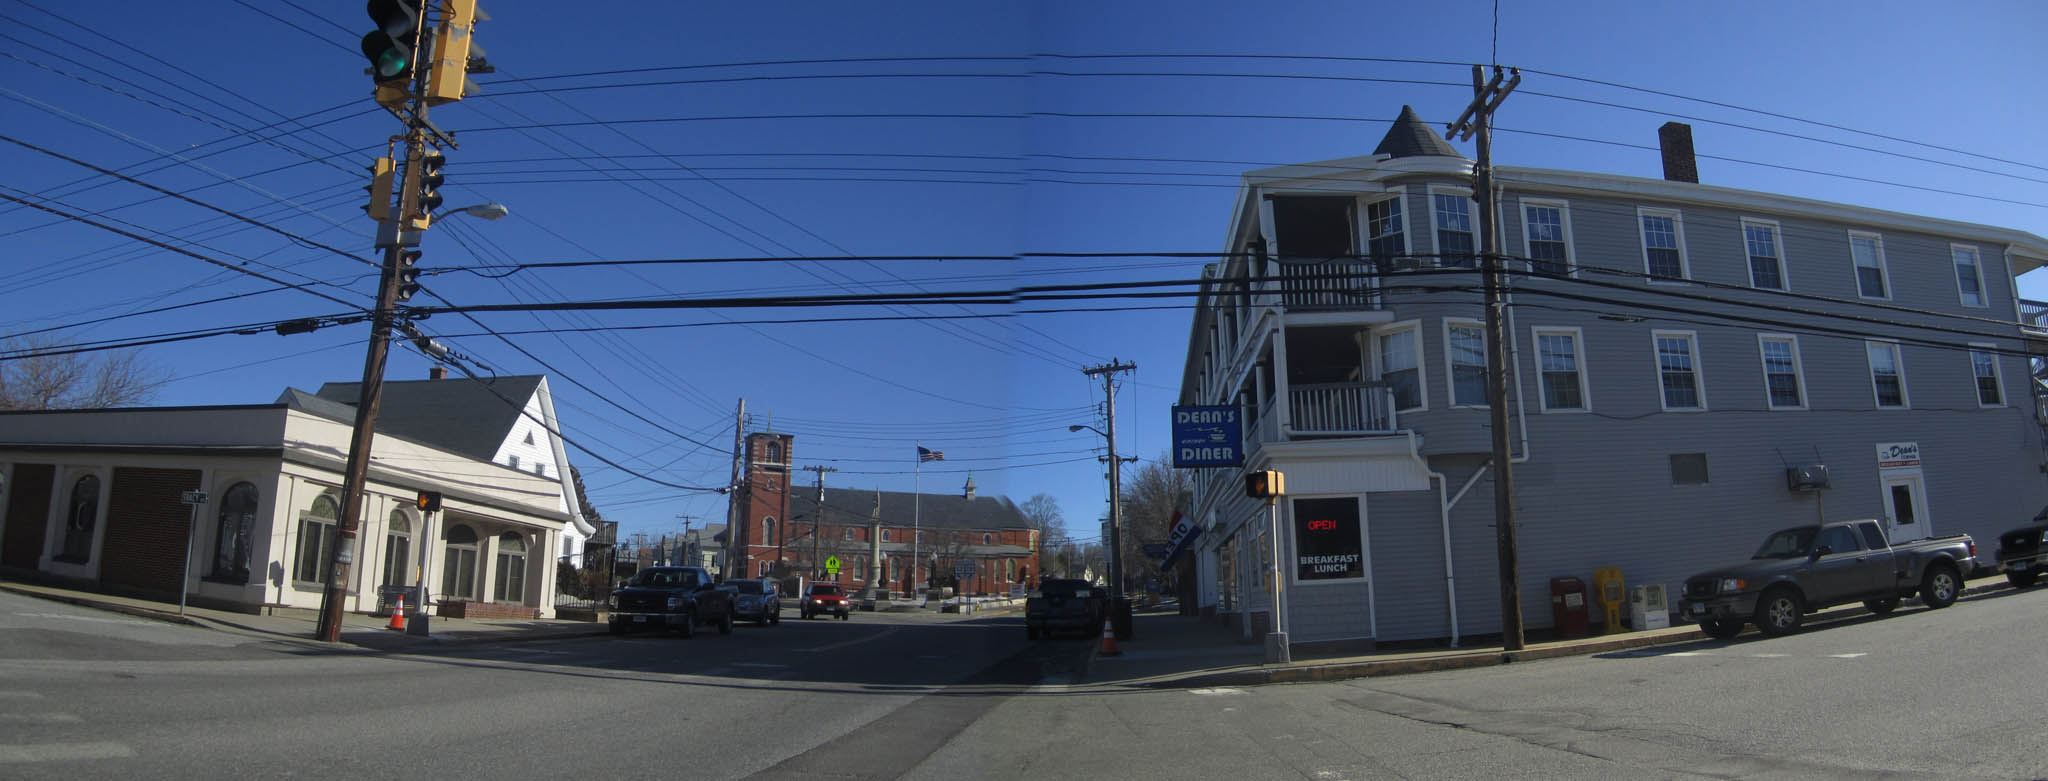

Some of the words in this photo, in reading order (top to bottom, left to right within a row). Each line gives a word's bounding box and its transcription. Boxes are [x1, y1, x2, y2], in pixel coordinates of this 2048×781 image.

[1177, 410, 1235, 424] DEAN'S
[1181, 447, 1233, 461] DINER
[1307, 519, 1337, 531] OPEN
[1300, 554, 1360, 565] BREAKFAST
[1314, 563, 1348, 574] LUNCH
